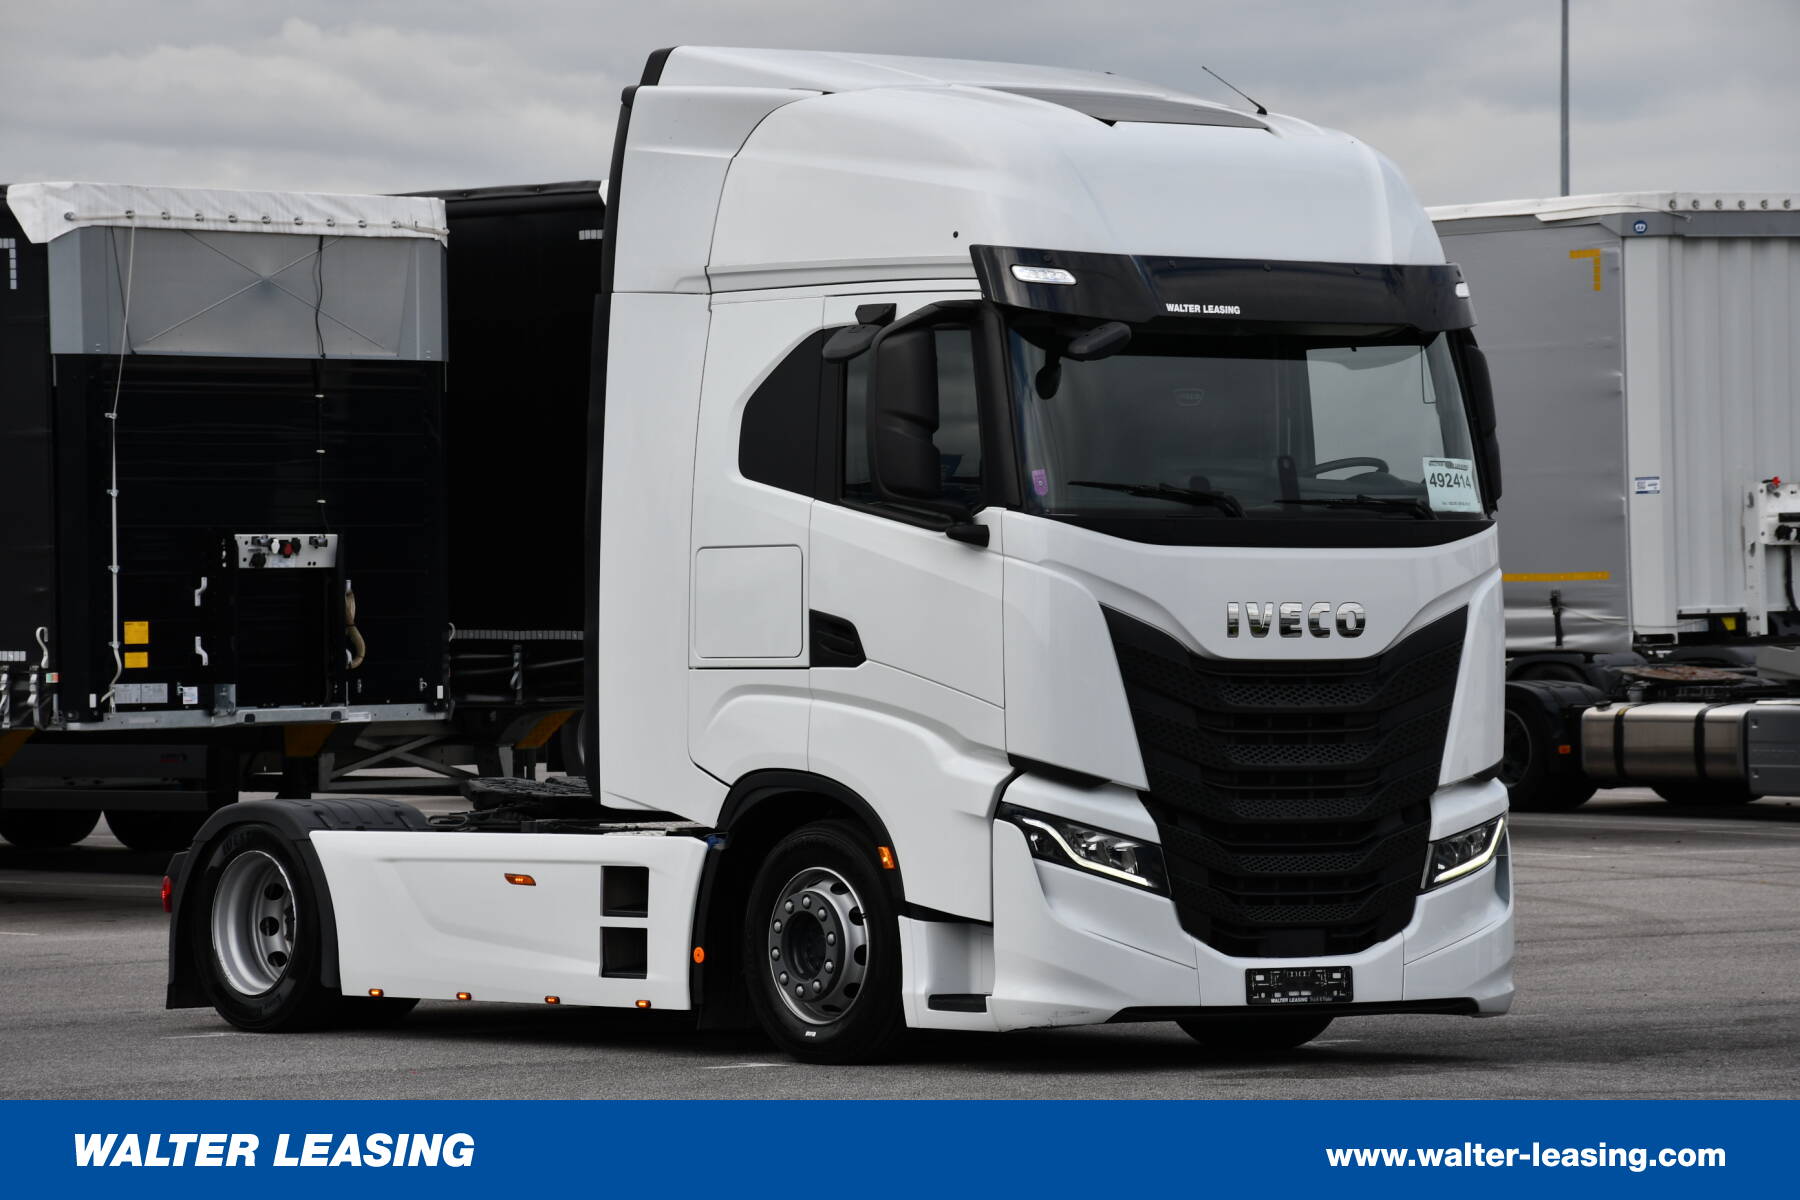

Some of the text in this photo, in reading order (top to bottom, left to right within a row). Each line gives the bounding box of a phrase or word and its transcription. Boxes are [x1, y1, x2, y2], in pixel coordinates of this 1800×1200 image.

[1165, 303, 1240, 315] WALTER LEASING
[1429, 472, 1472, 488] 492414
[1226, 601, 1366, 639] IVECO
